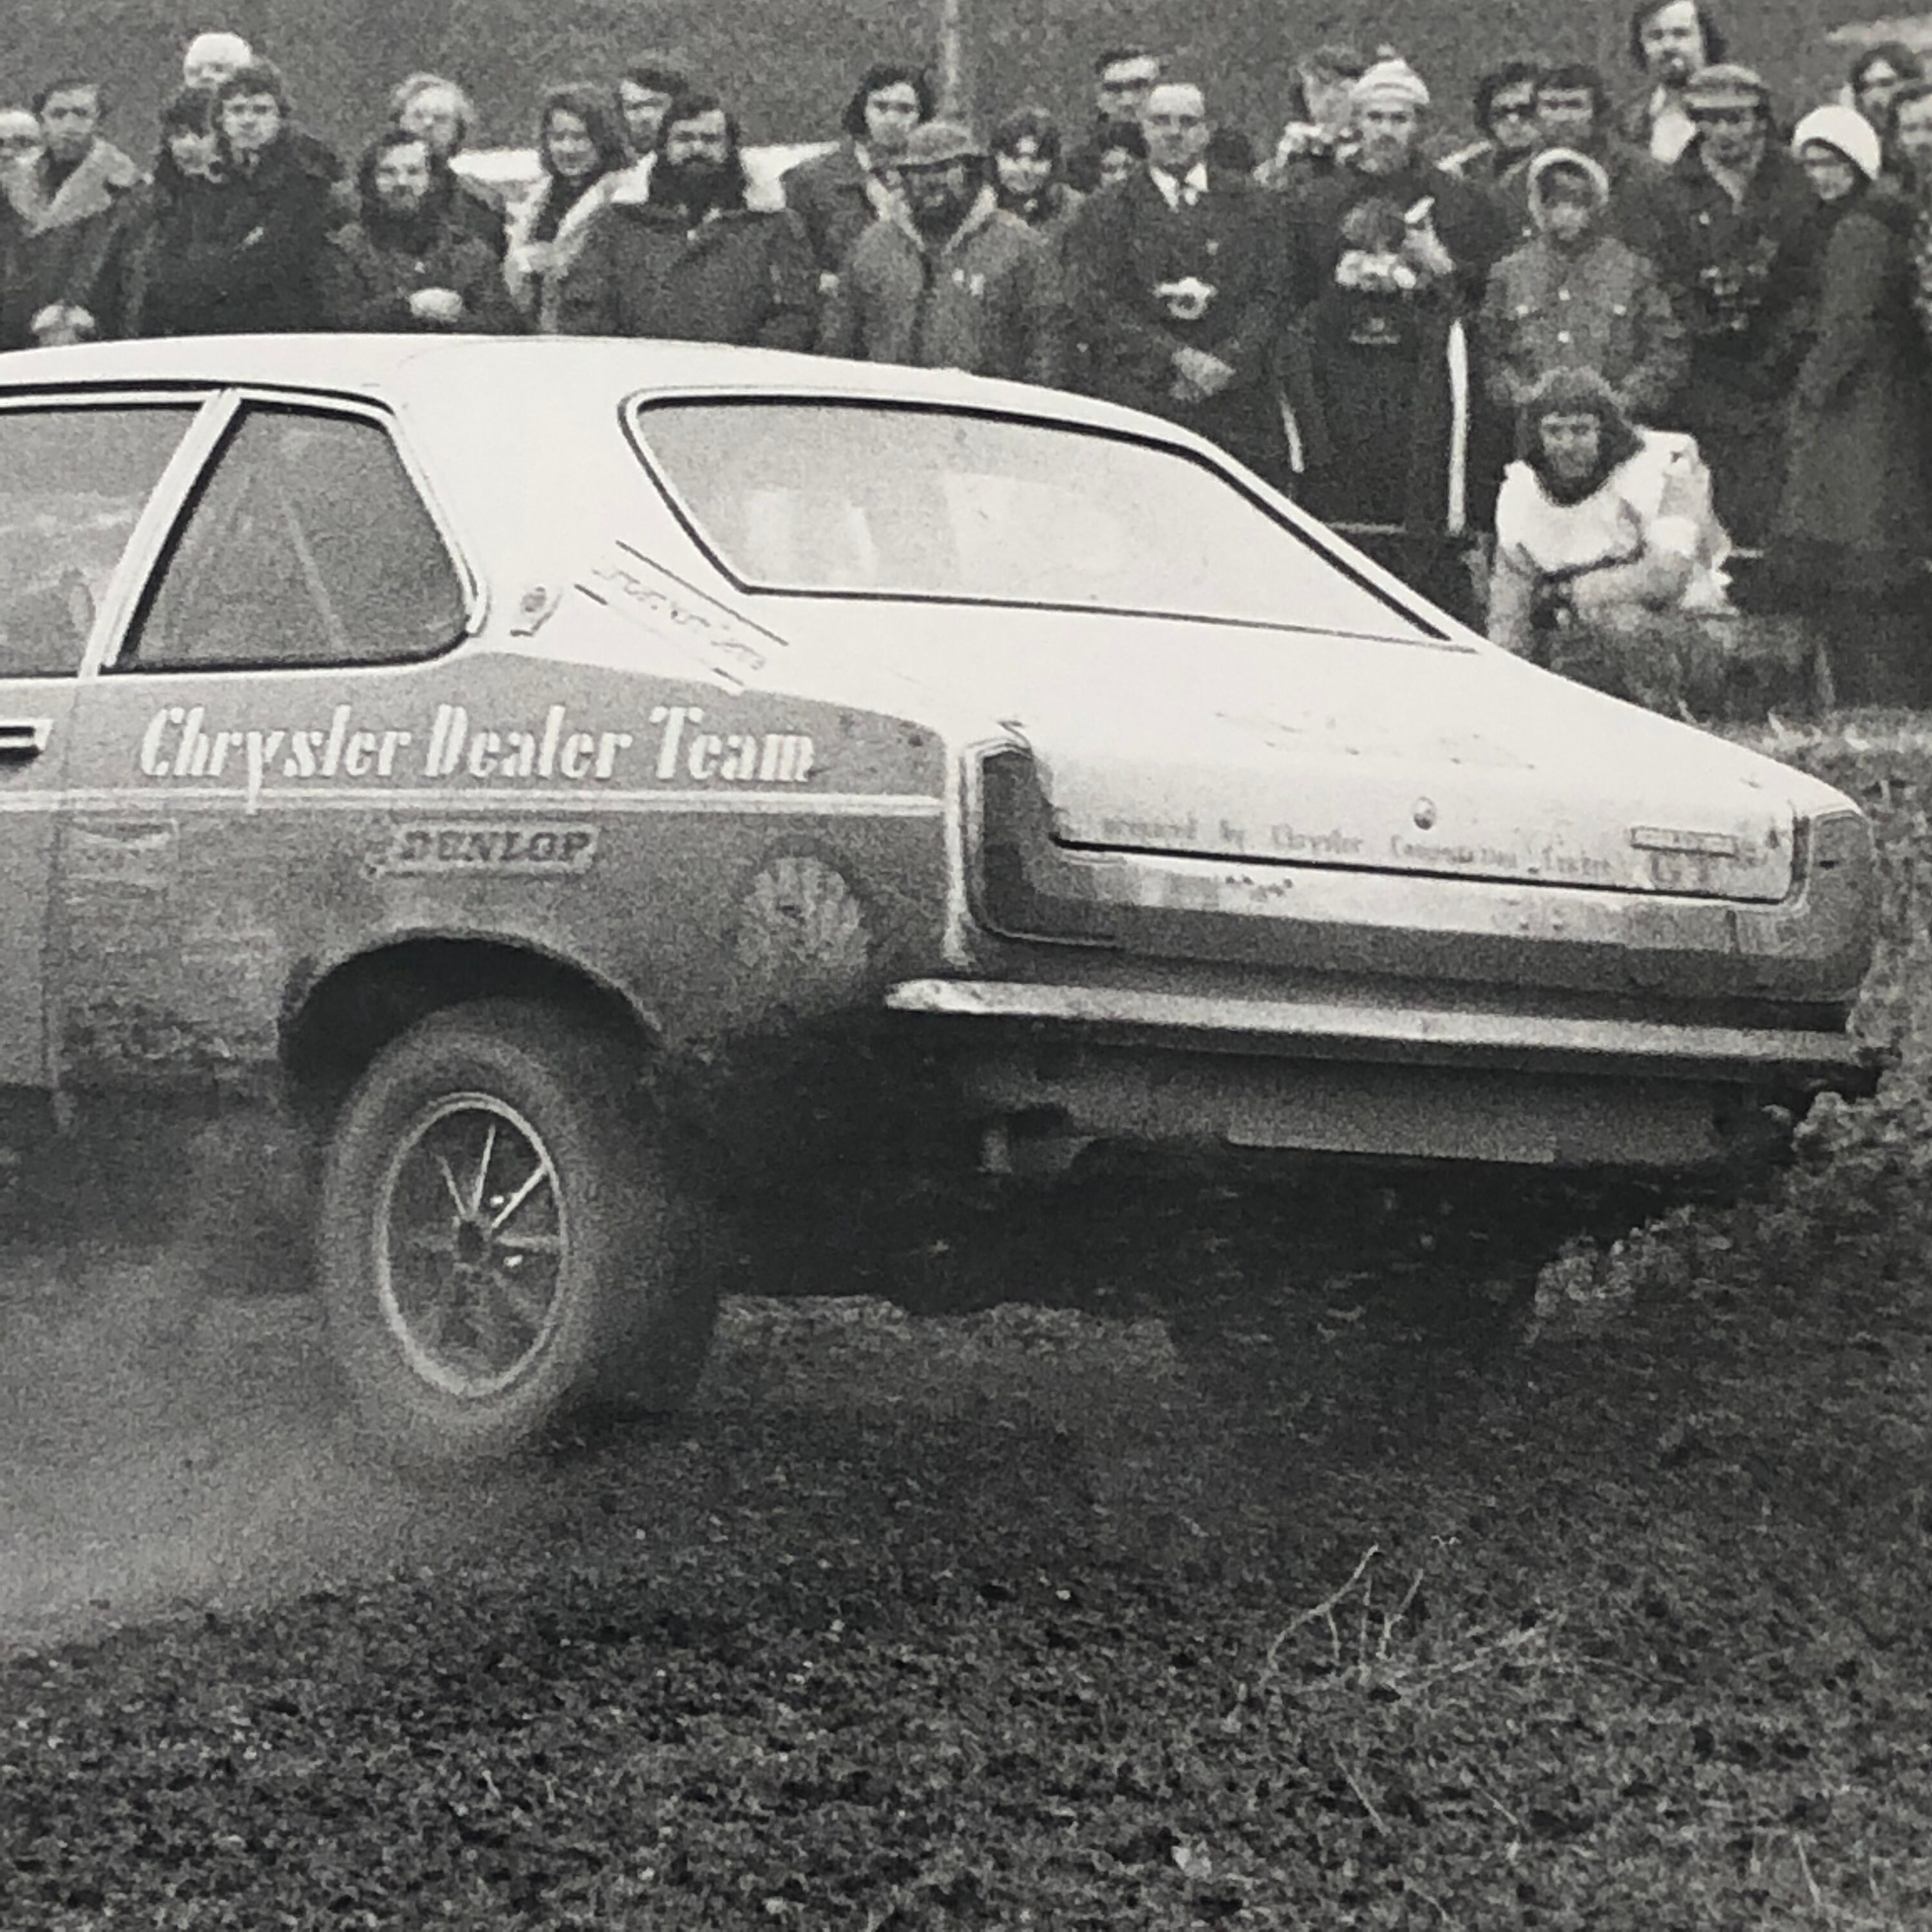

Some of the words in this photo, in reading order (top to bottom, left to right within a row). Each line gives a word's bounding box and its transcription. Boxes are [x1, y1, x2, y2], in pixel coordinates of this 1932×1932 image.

[140, 704, 412, 815] Chrysler
[425, 703, 633, 778] Dealer
[649, 706, 814, 782] Team
